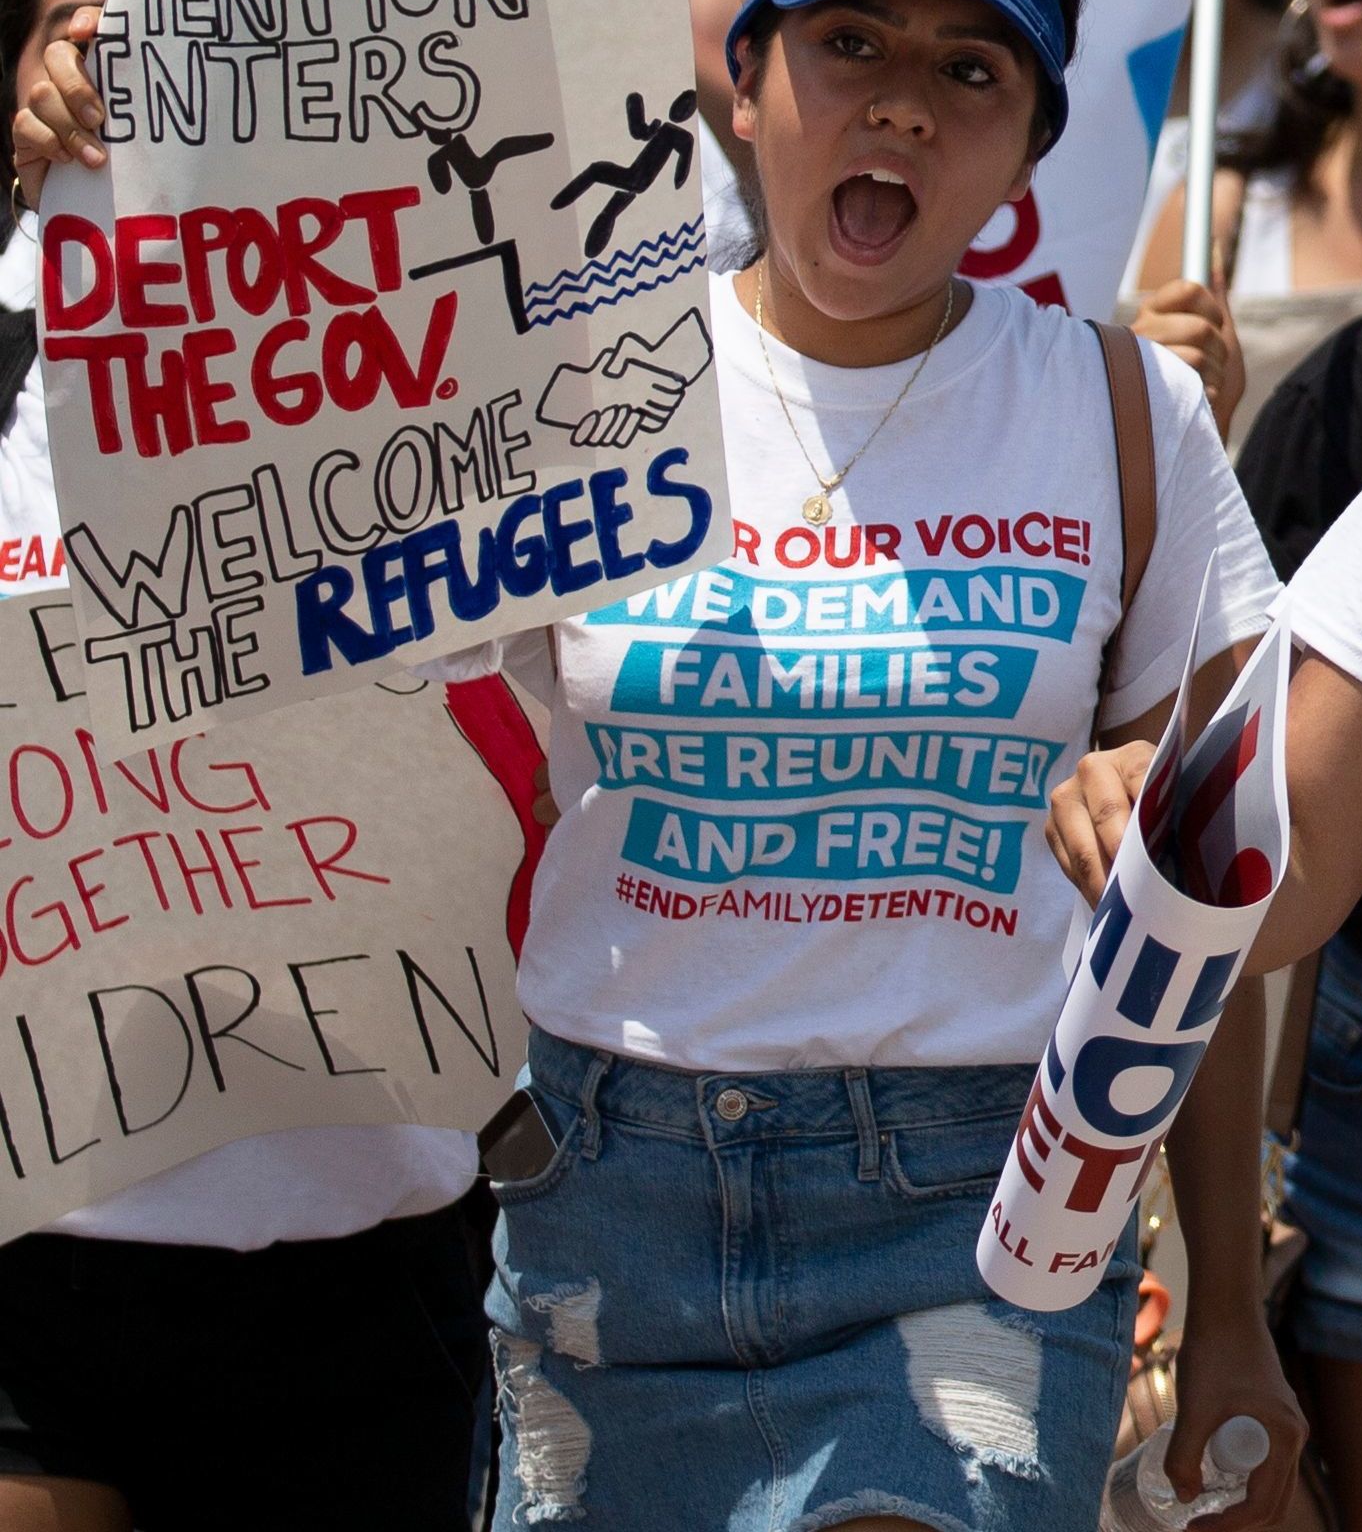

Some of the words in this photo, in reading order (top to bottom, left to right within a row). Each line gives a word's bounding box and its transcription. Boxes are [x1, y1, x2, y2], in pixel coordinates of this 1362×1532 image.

[96, 28, 482, 145] ENTERS
[42, 185, 421, 332] DEPORT
[44, 327, 251, 458] THE
[251, 291, 460, 427] GOV.
[64, 389, 538, 629] WELCOME
[774, 522, 902, 571] OUR
[914, 511, 1094, 567] VOICE!
[84, 595, 272, 734] THE
[295, 446, 713, 677] REFUGEES
[626, 569, 734, 625] WE
[750, 573, 1062, 633] DEMAND
[659, 647, 1002, 711] FAMILIES
[725, 732, 1056, 799] REUNITED
[653, 811, 797, 873] AND
[815, 810, 1003, 881] FREE!
[615, 872, 1020, 937] #ENDFAMILYDETENTION
